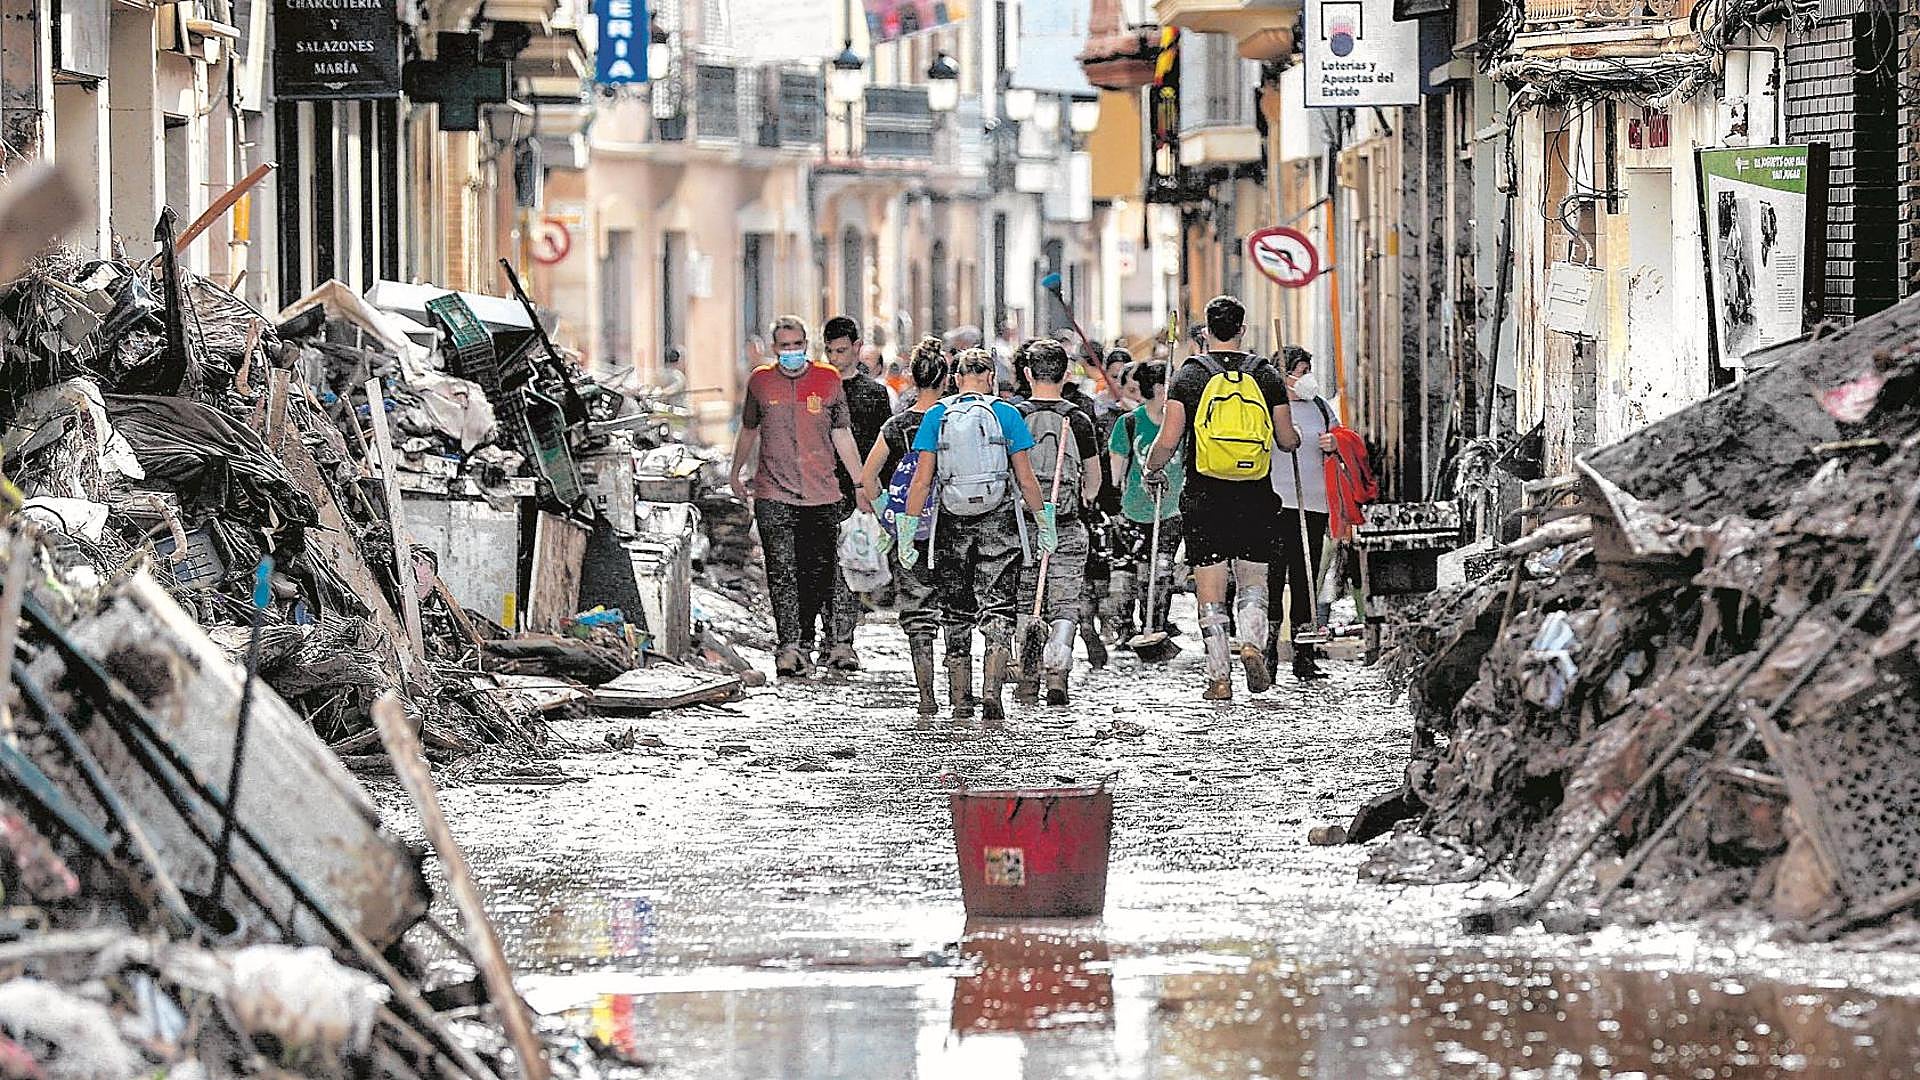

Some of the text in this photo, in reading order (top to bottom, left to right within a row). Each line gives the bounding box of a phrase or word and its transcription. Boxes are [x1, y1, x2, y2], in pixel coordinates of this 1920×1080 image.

[330, 18, 340, 30] Y
[295, 40, 375, 53] SALAZONES
[314, 60, 359, 74] MARÍA
[1369, 62, 1376, 73] y
[1322, 72, 1395, 86] Apuestas del
[1322, 87, 1360, 97] Estado
